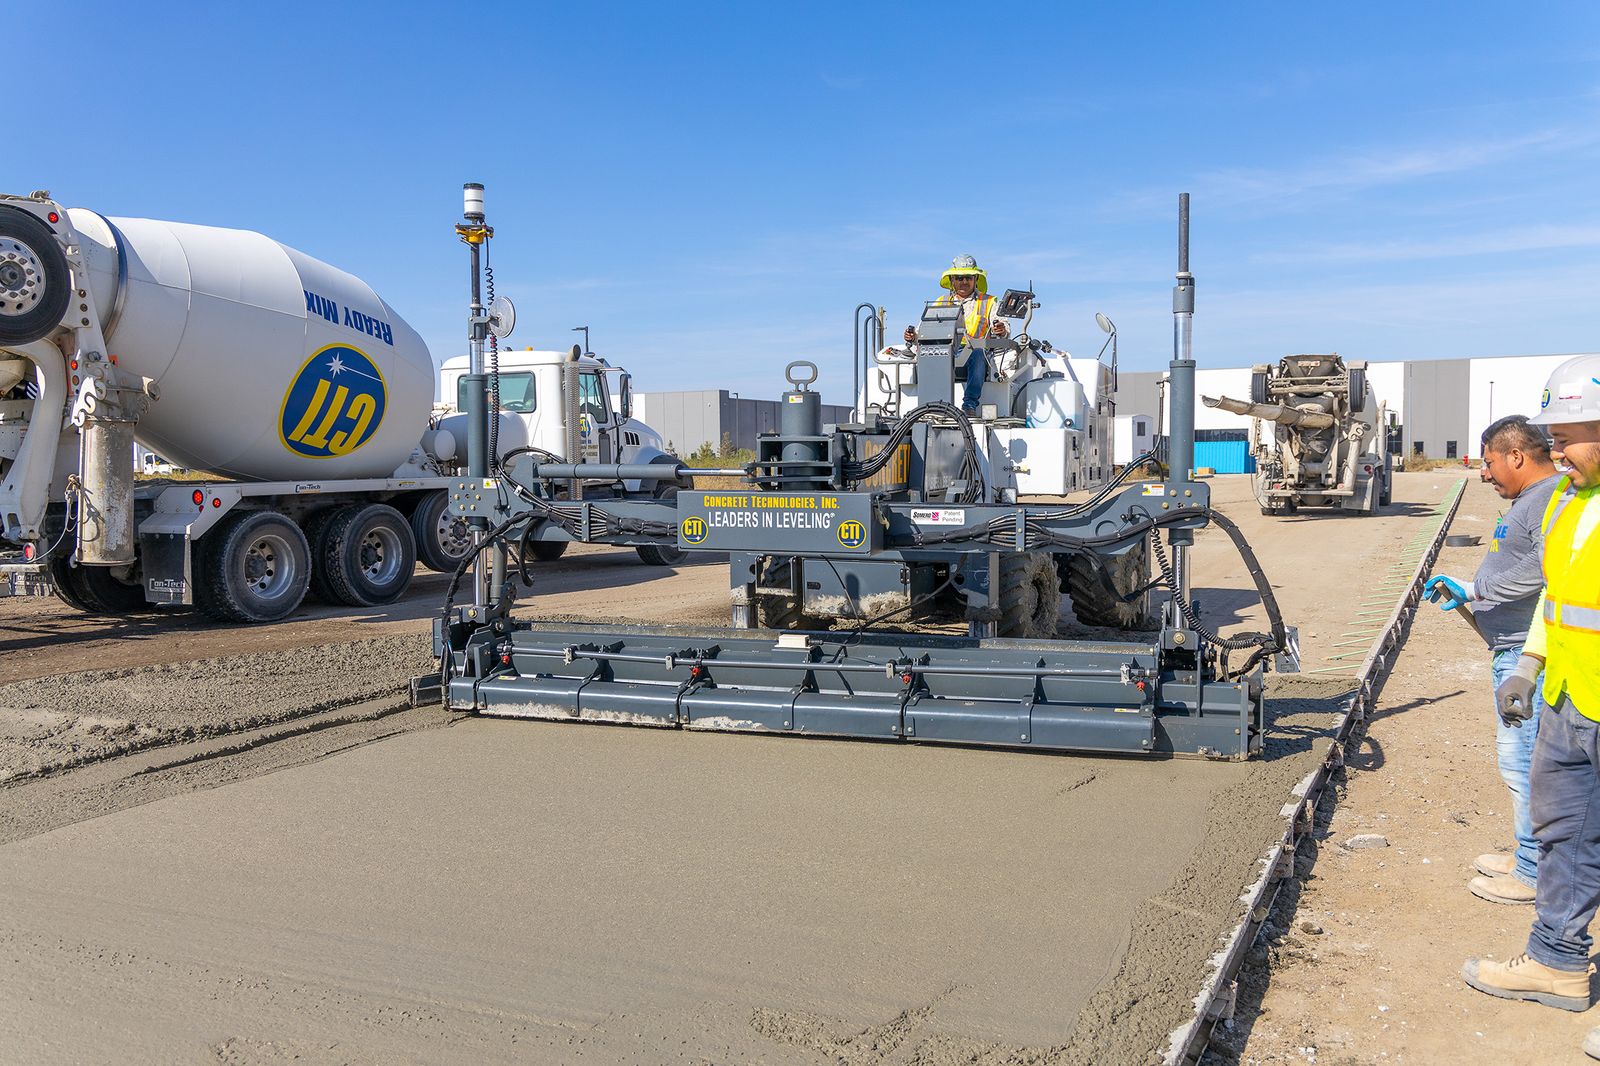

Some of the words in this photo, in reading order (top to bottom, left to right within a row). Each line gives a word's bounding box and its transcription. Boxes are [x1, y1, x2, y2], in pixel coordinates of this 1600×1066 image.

[304, 290, 339, 325] MIX
[344, 306, 394, 346] READY
[288, 378, 377, 456] CTI
[703, 495, 748, 508] CONCRETE
[751, 496, 819, 510] TECHNOLOGIES,
[821, 497, 840, 509] INC.
[684, 520, 702, 536] CTI
[708, 511, 759, 528] LEADERS
[762, 511, 773, 528] IN
[840, 523, 860, 540] CTI
[149, 577, 186, 593] Con-Tech
